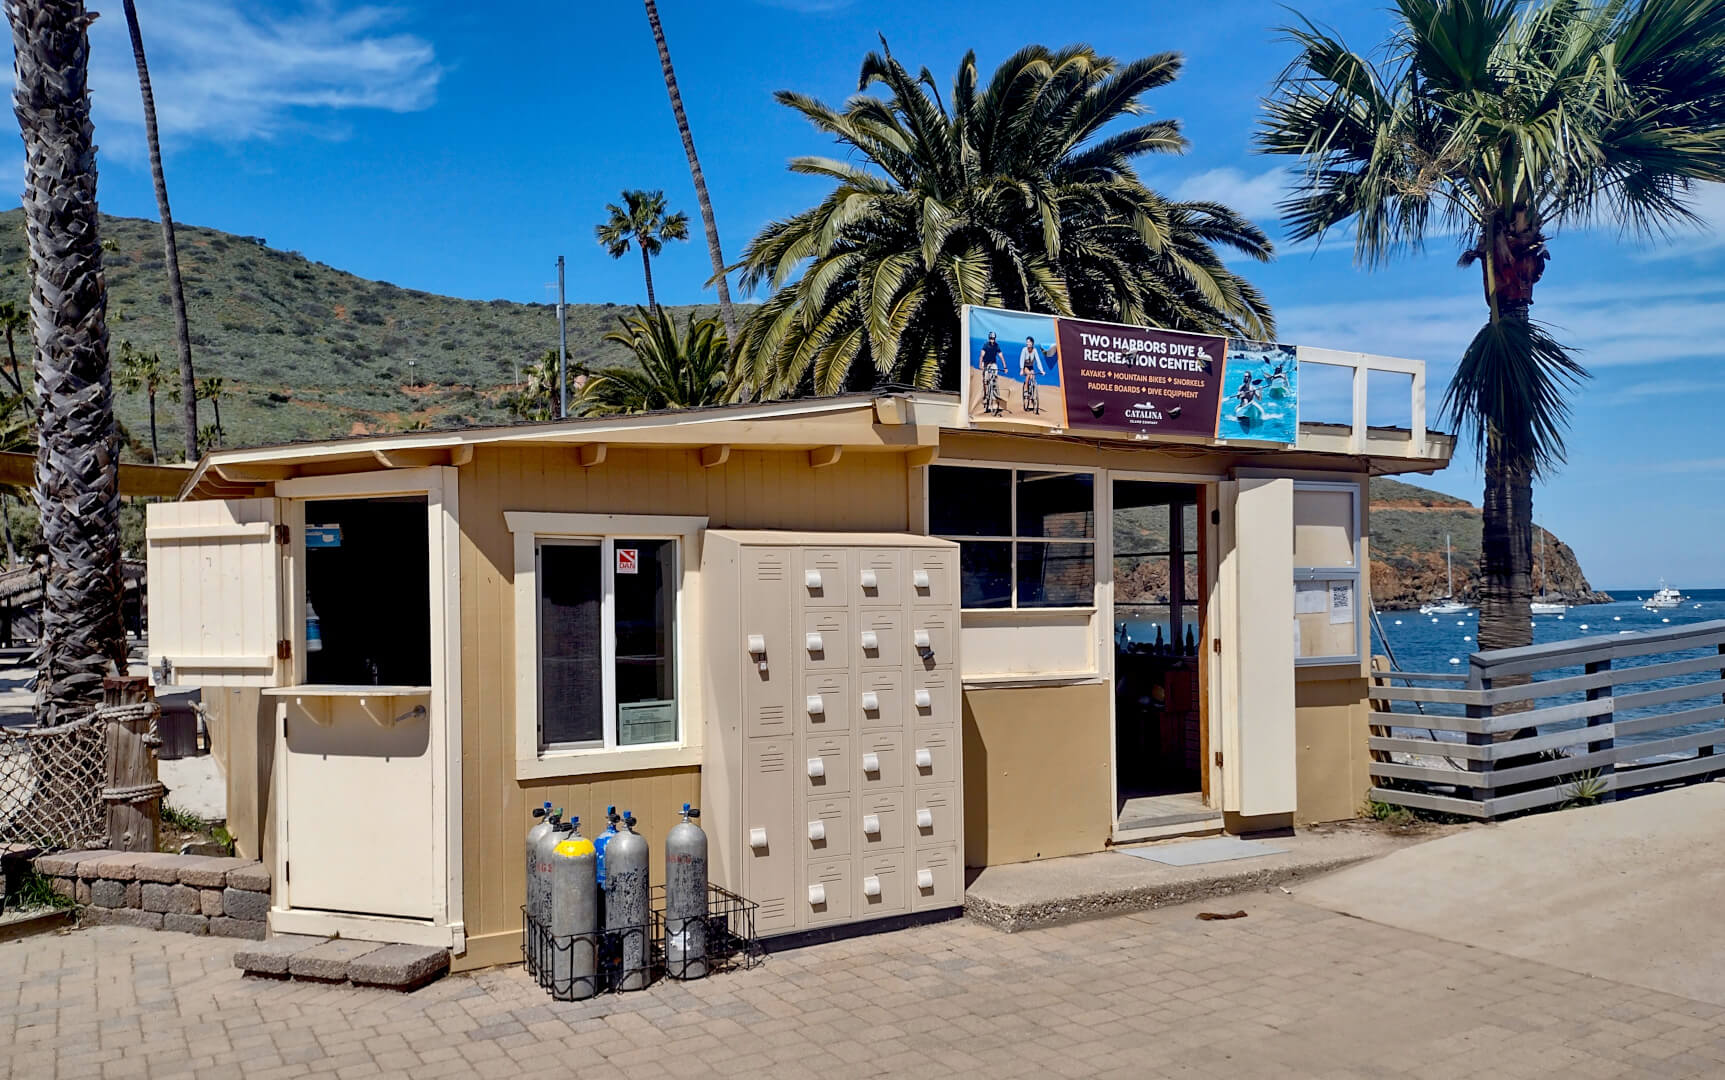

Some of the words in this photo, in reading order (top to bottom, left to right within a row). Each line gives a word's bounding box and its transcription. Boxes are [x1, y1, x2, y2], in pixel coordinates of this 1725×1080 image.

[1080, 333, 1110, 348] TWO
[1113, 337, 1167, 354] HARBORS
[1169, 343, 1195, 357] DIVE
[1196, 346, 1206, 358] &
[1158, 357, 1203, 373] CENTER
[1080, 369, 1106, 378] KAYAKS
[1113, 372, 1148, 382] MOUNTAIN
[1148, 375, 1167, 384] BIKES
[1173, 377, 1205, 388] SNORKELS
[1088, 382, 1113, 392] PADDLE
[1113, 385, 1141, 394] BOARDS
[1147, 387, 1163, 395] DIVE
[1163, 388, 1199, 399] EQUIPMENT
[1124, 409, 1163, 420] CATALINA
